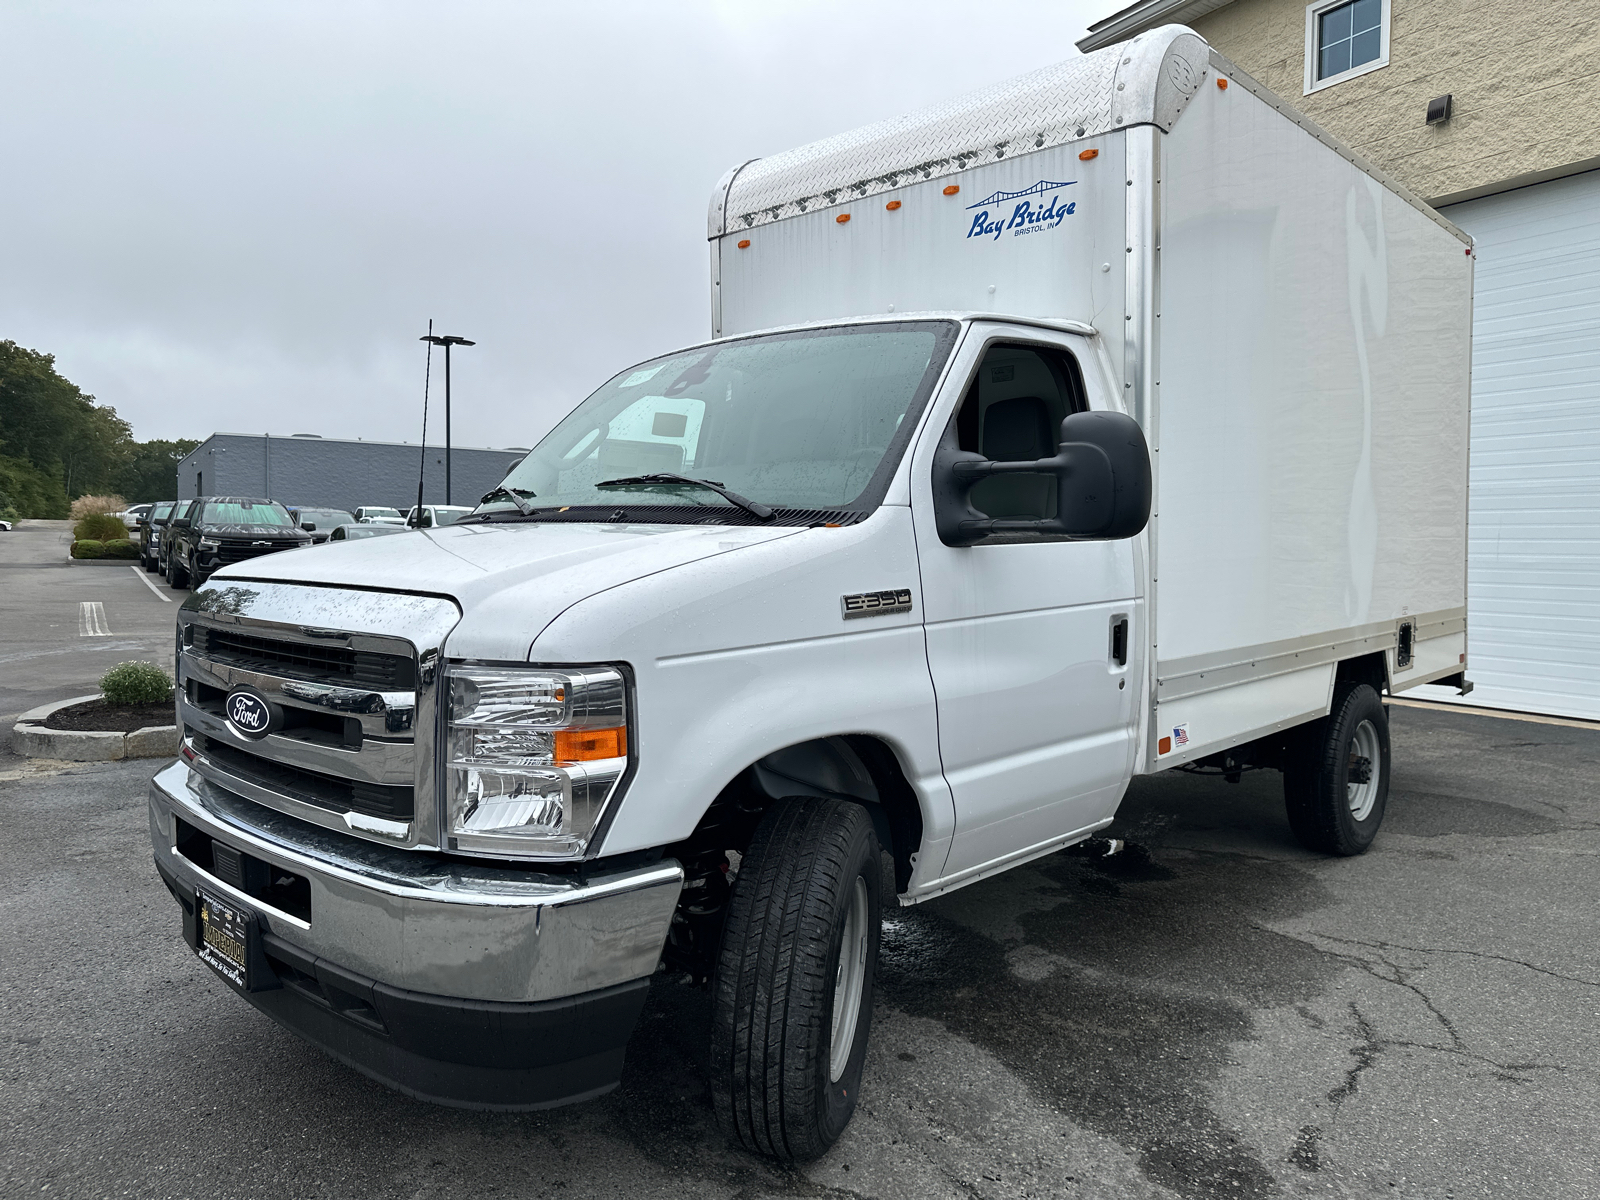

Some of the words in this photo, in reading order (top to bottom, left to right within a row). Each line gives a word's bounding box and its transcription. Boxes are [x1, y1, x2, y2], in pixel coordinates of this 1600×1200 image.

[966, 210, 1006, 241] Bay
[1006, 195, 1077, 231] Bridge
[1014, 224, 1046, 237] BRISTOL,
[1046, 221, 1055, 230] IN
[233, 696, 260, 727] Ford
